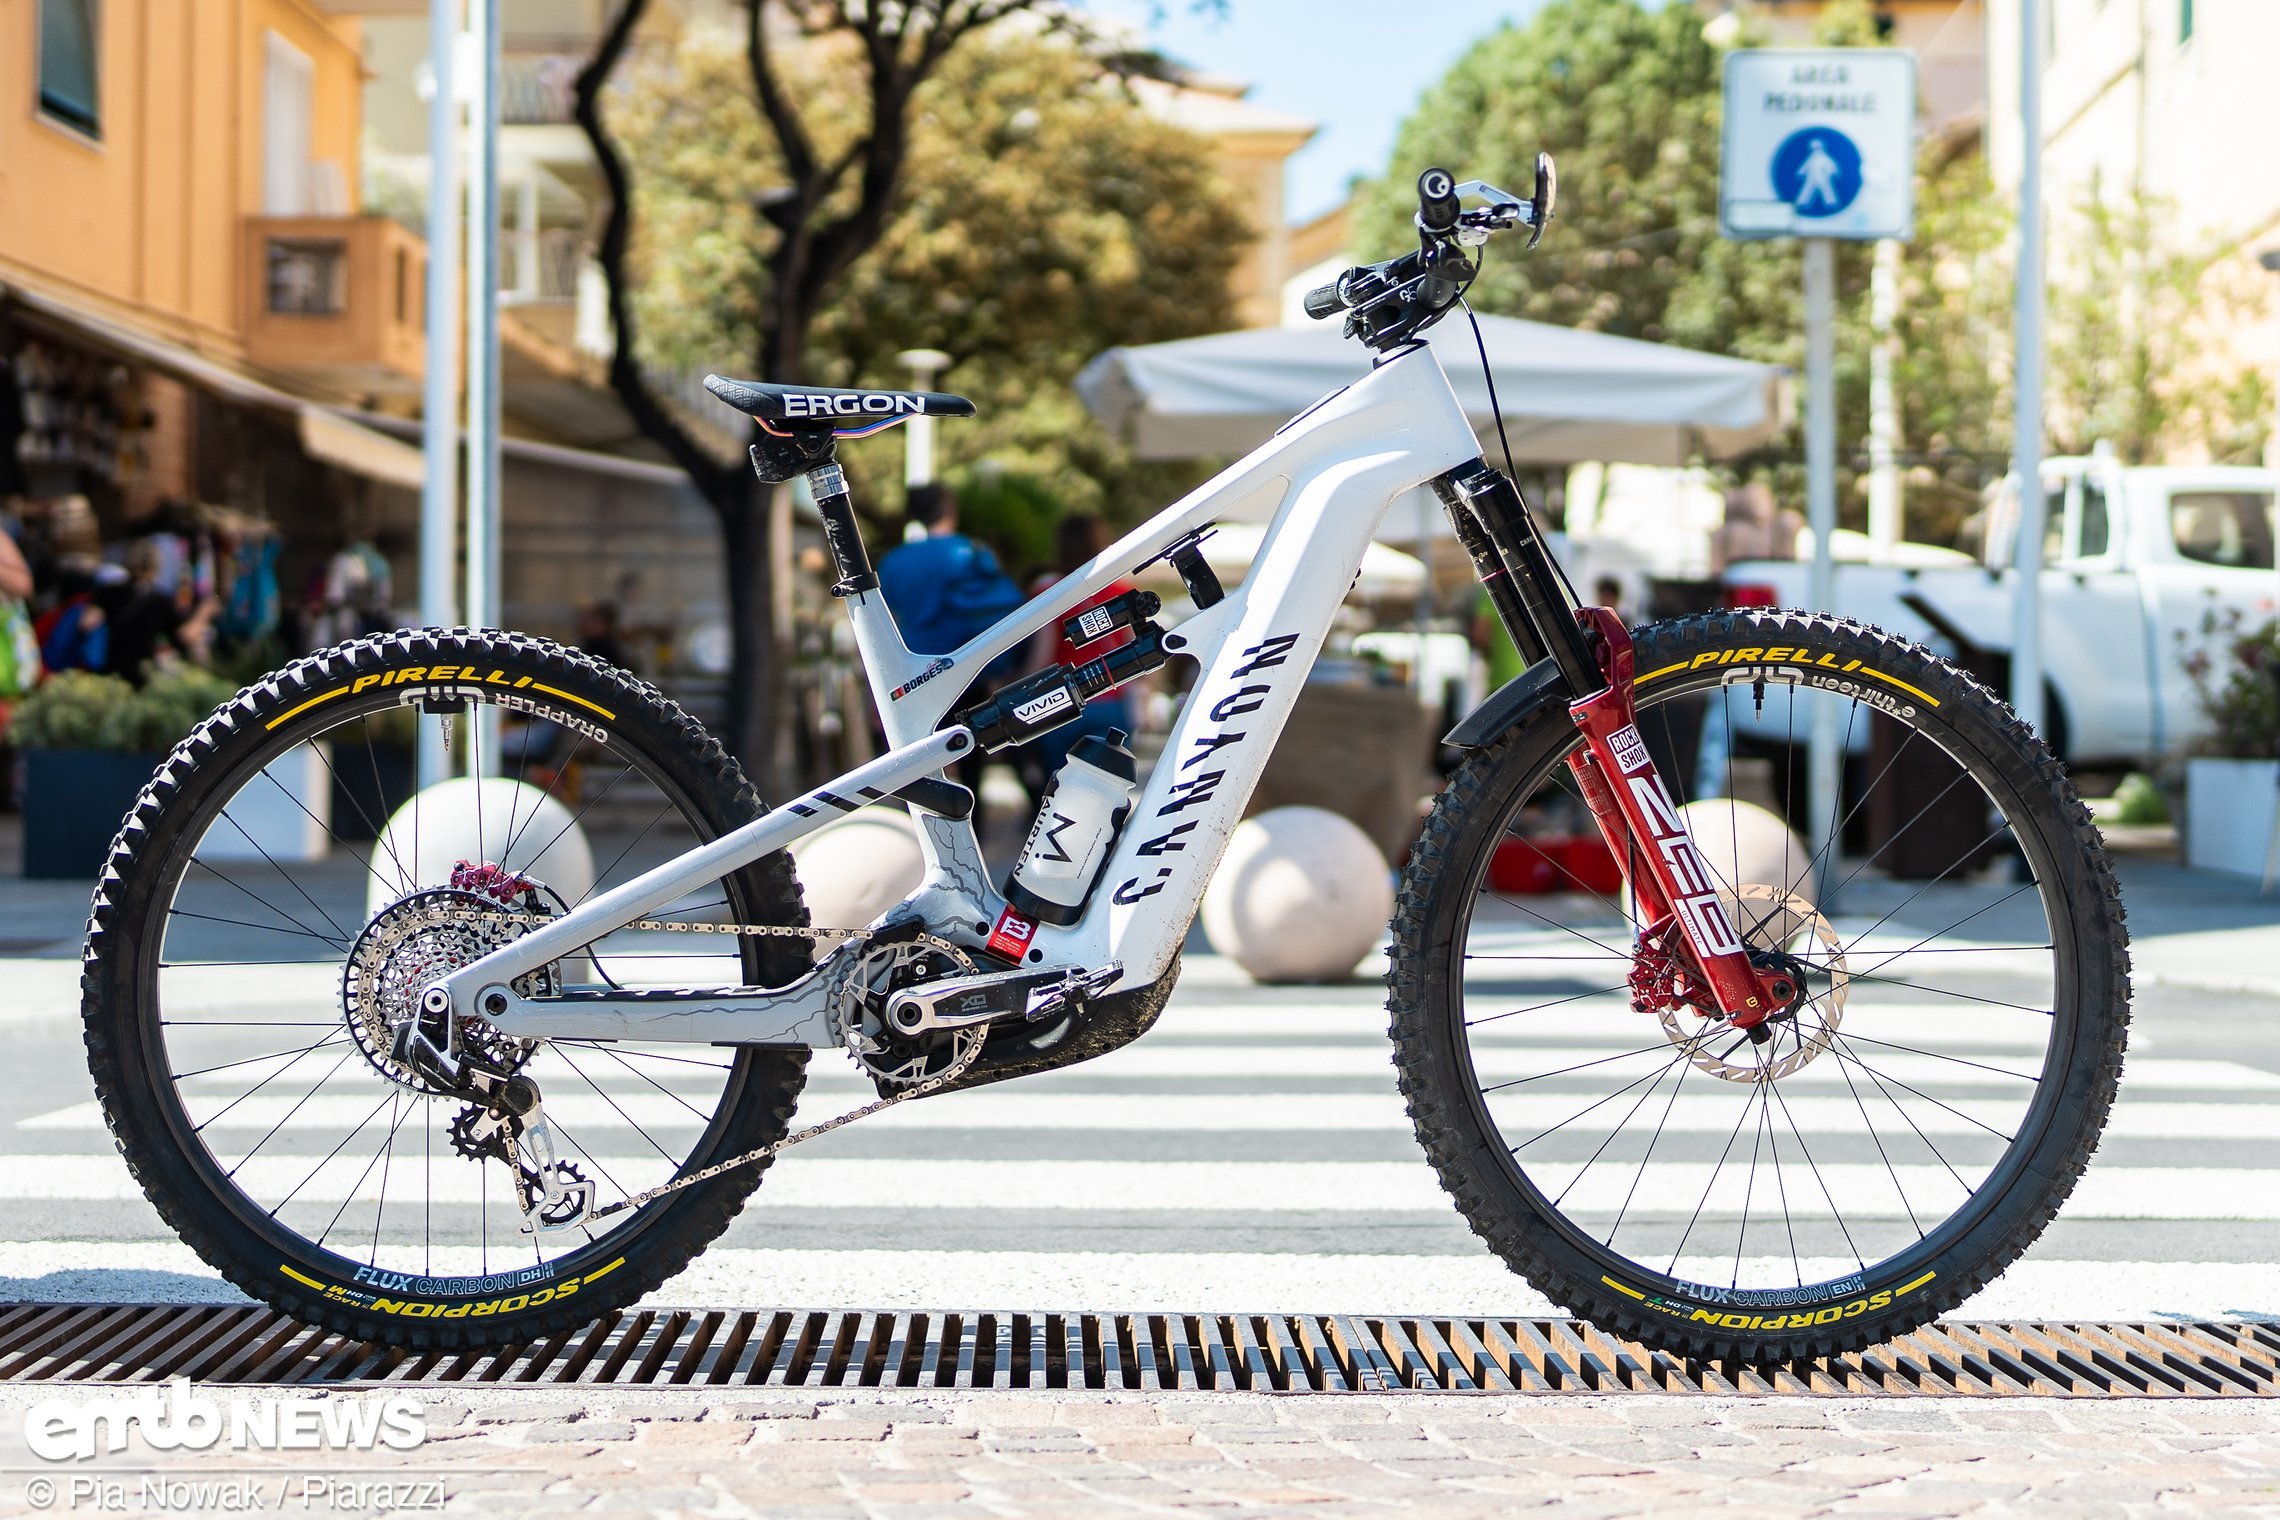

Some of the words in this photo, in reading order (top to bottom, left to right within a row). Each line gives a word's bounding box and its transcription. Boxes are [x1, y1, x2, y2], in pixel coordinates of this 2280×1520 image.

[1791, 64, 1850, 84] AREA
[1762, 92, 1876, 113] PEDONALE
[1399, 285, 1417, 302] G5
[783, 393, 925, 417] ERGON
[1081, 613, 1097, 636] SHOX
[1092, 607, 1112, 630] ROCK
[1690, 647, 1862, 671] PIRELLI
[352, 665, 533, 694] PIRELLI
[903, 664, 944, 694] BORGES
[1018, 691, 1066, 718] VIVID
[494, 692, 609, 745] GRAPPLER
[1612, 727, 1638, 752] ROCK
[1112, 632, 1300, 906] CANYON
[1621, 747, 1647, 769] SHOX
[1681, 909, 1702, 947] ULTIMATE
[353, 1266, 415, 1292] FLUX
[415, 1272, 514, 1296] CARBON
[520, 1270, 542, 1283] DH
[323, 1291, 361, 1307] RACE
[370, 1276, 580, 1318] SCORPION
[1675, 1281, 1729, 1305] FLUX
[1733, 1284, 1828, 1307] CARBON
[1833, 1281, 1852, 1294] EN
[1644, 1301, 1681, 1316] RACE
[1689, 1289, 1892, 1330] SCORPION
